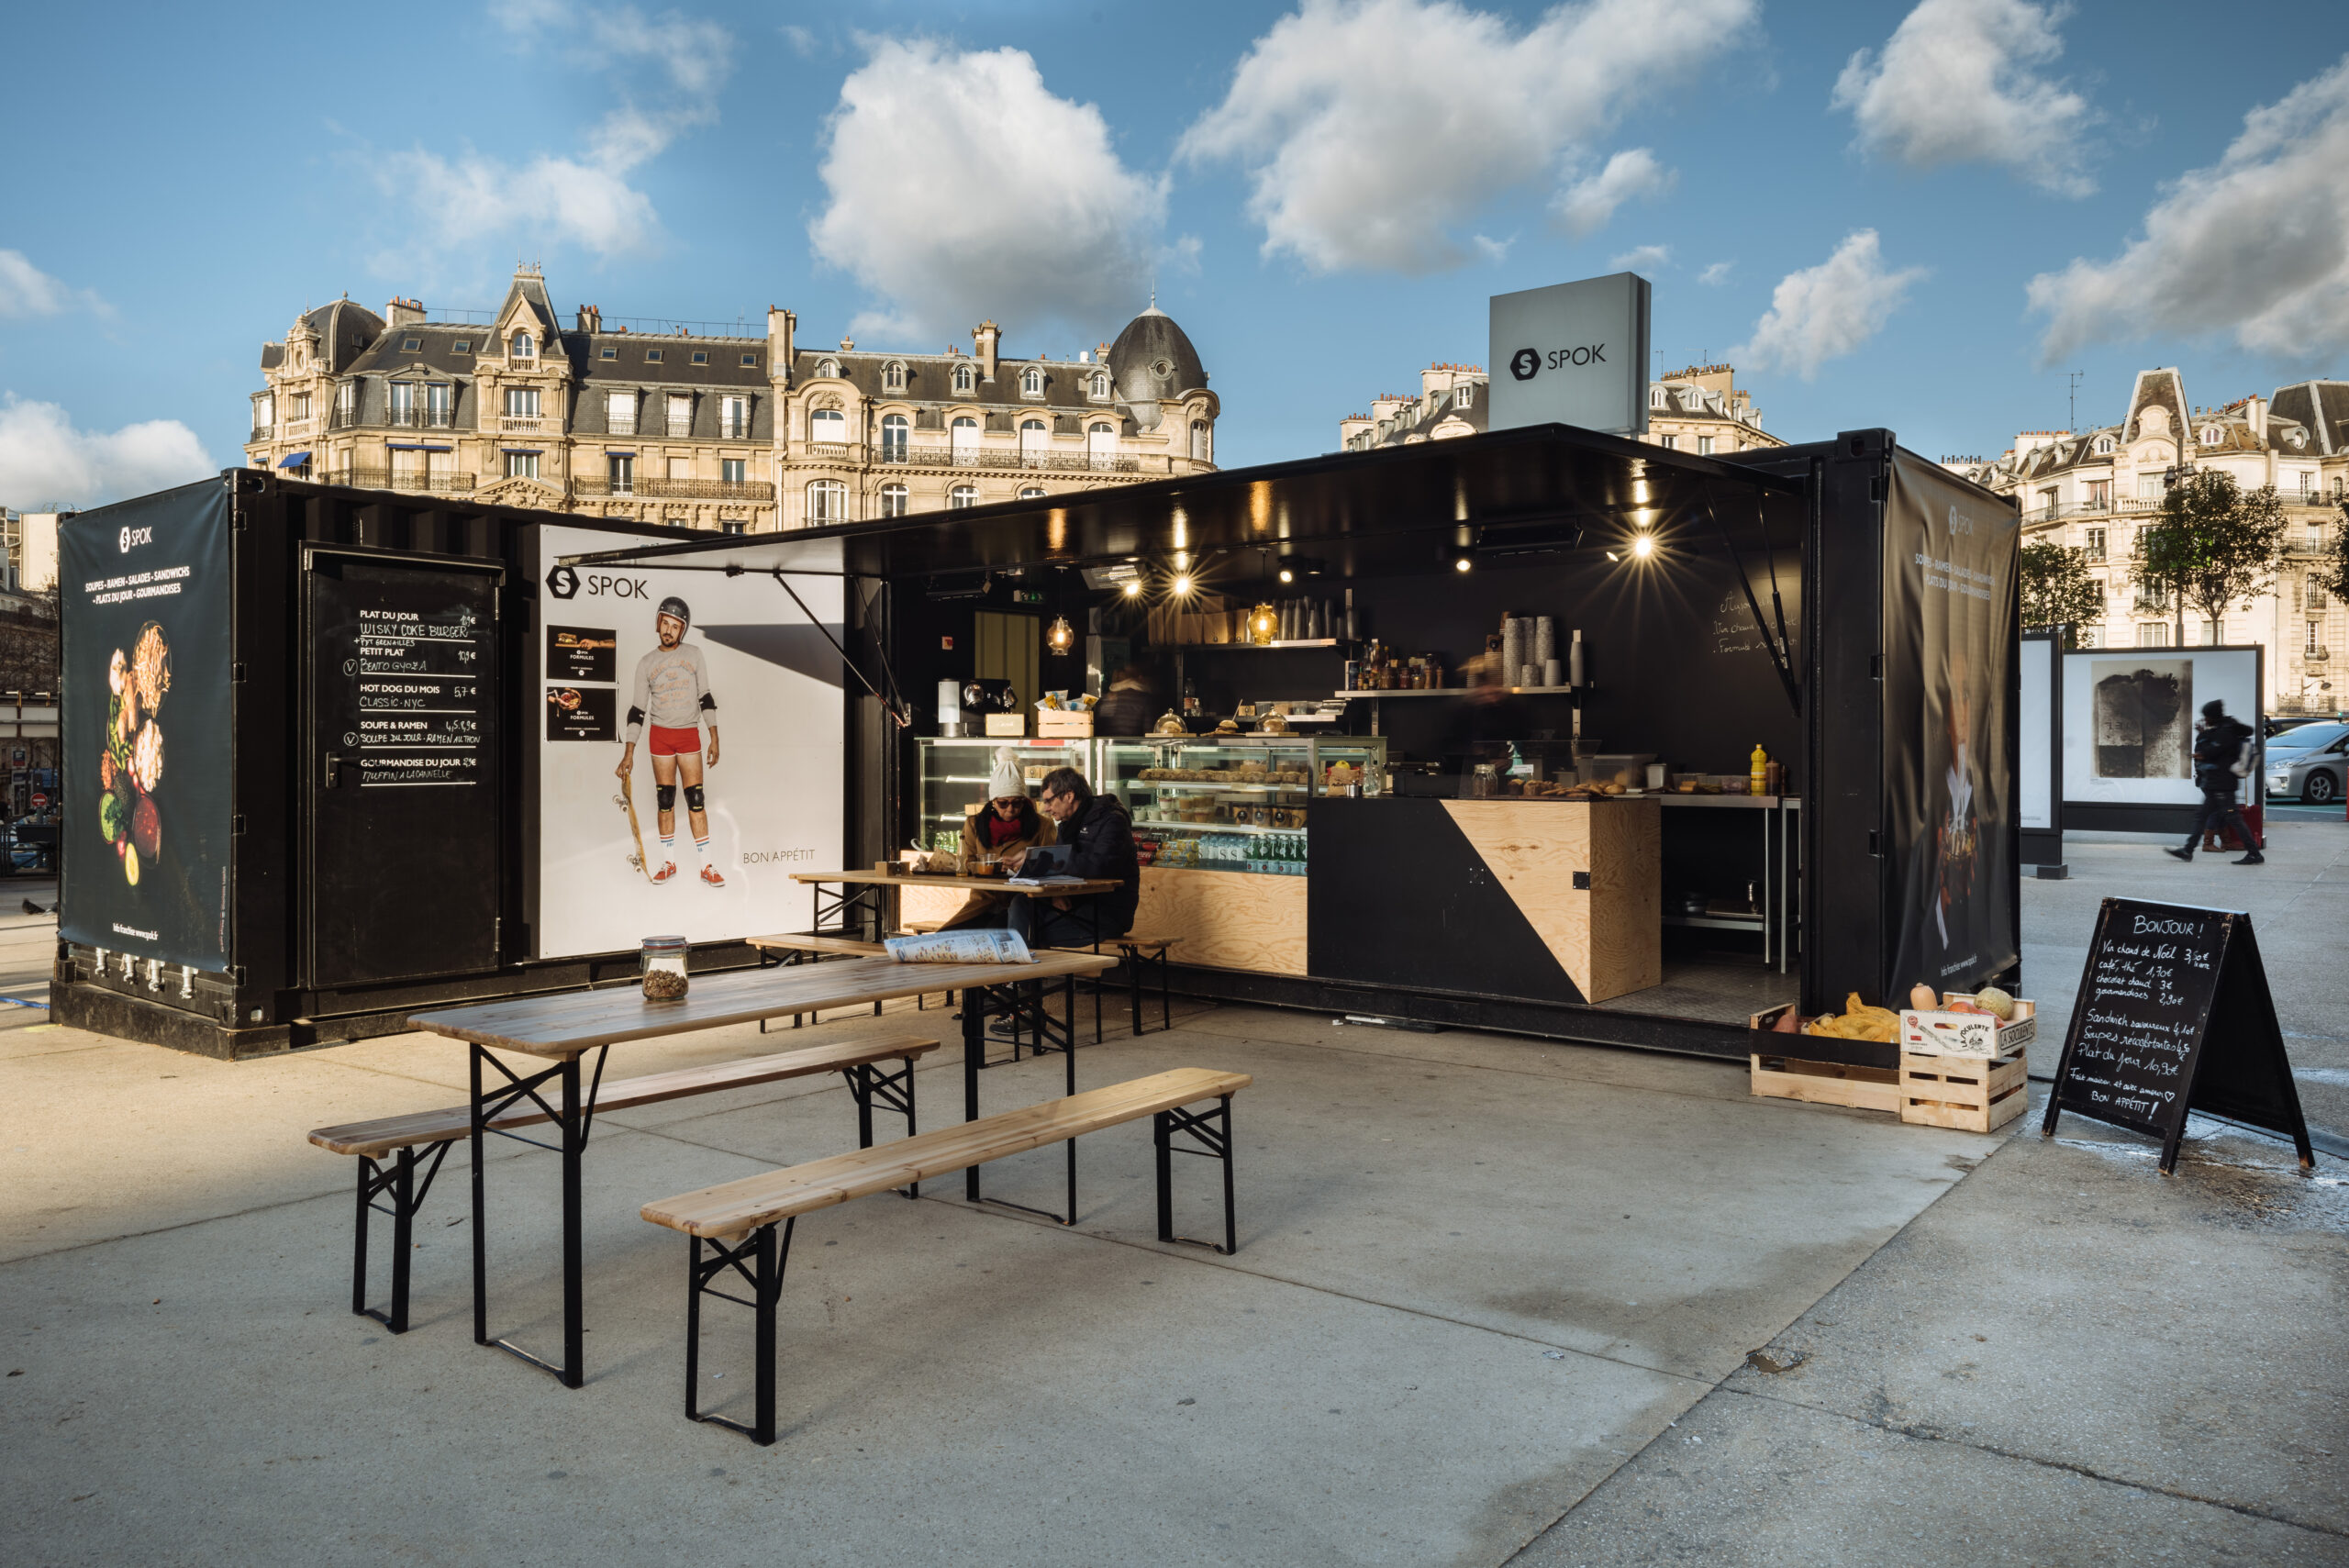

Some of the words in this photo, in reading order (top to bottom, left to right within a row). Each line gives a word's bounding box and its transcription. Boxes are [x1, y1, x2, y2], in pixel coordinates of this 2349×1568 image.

[1547, 343, 1607, 370] SPOK
[131, 526, 152, 547] SPOK
[85, 580, 105, 593] SOUPES
[106, 577, 126, 589] RAMEN
[128, 573, 151, 585] SALADES
[154, 566, 190, 582] SANDWICHS
[587, 574, 650, 600] SPOK
[1939, 577, 1947, 588] DU
[95, 593, 111, 605] PLATS
[111, 592, 119, 602] DU
[119, 590, 133, 604] JOUR
[136, 583, 182, 598] GOURMANDISES
[360, 610, 380, 618] PLAT
[382, 611, 395, 619] DU
[396, 612, 419, 622] JOUR
[360, 623, 397, 637] WISKY
[401, 625, 426, 636] COKE
[429, 625, 469, 639] BURGER
[360, 647, 384, 655] PETIT
[385, 648, 405, 657] PLAT
[360, 684, 380, 693] HOT
[381, 684, 403, 693] DOG
[404, 685, 417, 694] DU
[419, 685, 440, 694] MOIS
[360, 721, 389, 729] SOUPE
[360, 734, 387, 743] SOUPE
[426, 734, 453, 744] RAMEN
[361, 759, 424, 767] GOURMANDISE
[425, 759, 439, 767] DU
[440, 759, 461, 768] JOUR
[743, 852, 769, 863] BON
[772, 847, 816, 862] APPÉTIT
[2133, 915, 2194, 935] BONJOUR
[2102, 940, 2114, 953] Vin
[2117, 942, 2140, 955] chaud
[2141, 944, 2150, 957] de
[2153, 943, 2177, 959] Noël
[2121, 961, 2143, 973] thé
[2097, 973, 2125, 985] chocolat
[2128, 975, 2151, 989] chaud
[2095, 988, 2148, 1002] gourmandises
[2086, 1008, 2128, 1028] Sandwich
[2130, 1019, 2170, 1032] savoureux
[2084, 1025, 2118, 1047] Soupes
[2077, 1042, 2102, 1058] Plat
[2102, 1047, 2115, 1061] du
[2116, 1049, 2141, 1073] jour
[2070, 1067, 2086, 1082] Fait
[2086, 1076, 2111, 1086] maison
[2139, 1087, 2165, 1098] amour
[2091, 1091, 2110, 1102] BON
[2115, 1095, 2150, 1113] APPÉTIT
